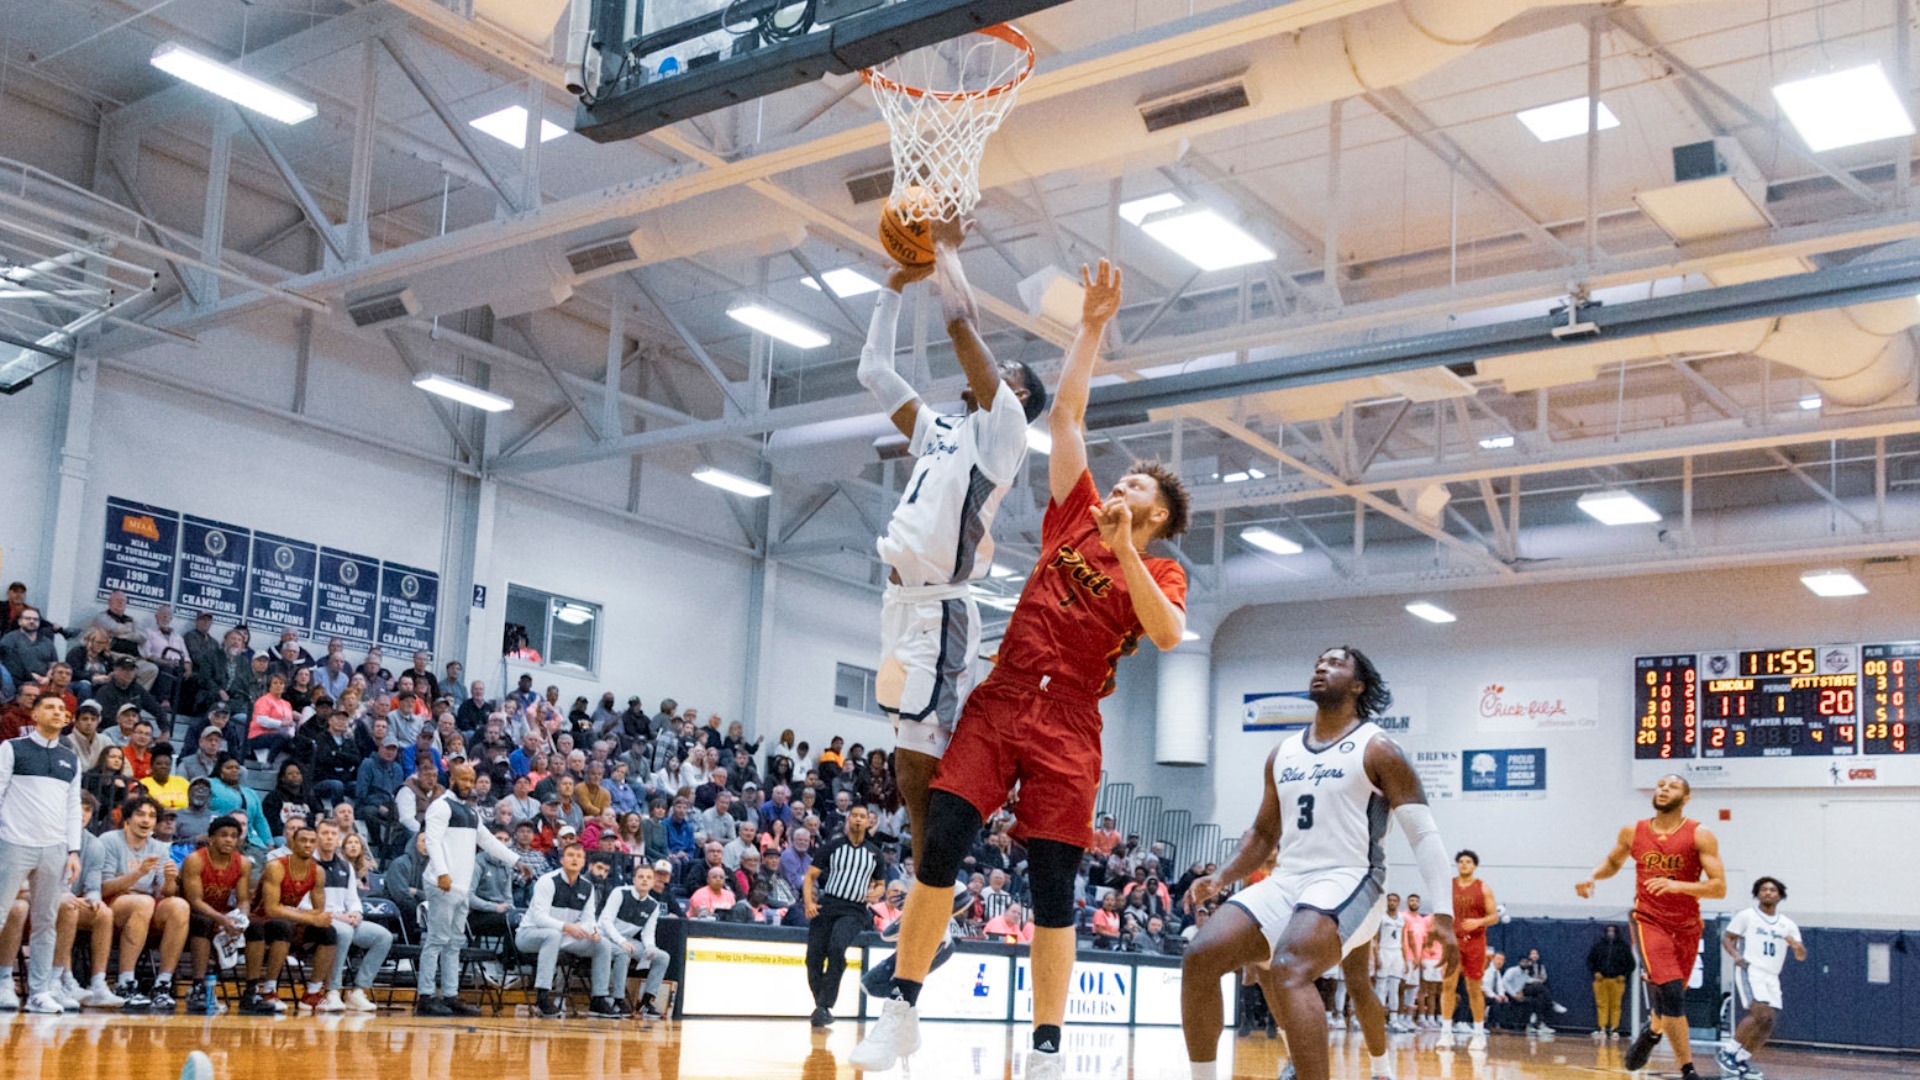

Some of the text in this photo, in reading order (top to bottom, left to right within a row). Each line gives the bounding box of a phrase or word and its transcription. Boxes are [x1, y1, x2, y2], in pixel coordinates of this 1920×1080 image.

[105, 577, 165, 598] CHAMPIONS
[201, 585, 222, 598] 1999
[475, 587, 484, 602] 2
[182, 593, 237, 612] CHAMPIONS
[270, 599, 290, 612] 2001
[253, 608, 305, 626] CHAMPIONS
[320, 621, 369, 639] CHAMPIONS
[382, 632, 429, 650] CHAMPIONS
[1750, 648, 1815, 675] 11:55
[1865, 659, 1904, 676] 00 0
[1646, 669, 1695, 685] 0 1 0
[1877, 675, 1904, 690] 3 1
[1651, 683, 1695, 698] 1 0 2
[1708, 679, 1754, 693] LINCOLN
[1763, 684, 1791, 693] PERIOD
[1647, 698, 1695, 714] 3 0 3
[1722, 695, 1745, 716] 11
[1777, 695, 1785, 713] 1
[1819, 689, 1854, 714] 20
[1876, 691, 1904, 706] 4 0
[1641, 713, 1695, 729] 10 0 0
[1750, 716, 1804, 727] PLAYER FOUL
[1828, 715, 1856, 724] FOULS
[1876, 707, 1904, 722] 5 1
[1637, 728, 1695, 744] 20 1 2
[1711, 727, 1726, 747] 2
[1735, 731, 1745, 746] 3
[1811, 730, 1822, 742] 4
[1838, 725, 1854, 742] 4
[1866, 723, 1904, 739] 23 0
[1661, 743, 1671, 758] 2
[1893, 740, 1905, 752] 4
[1417, 752, 1458, 761] BREWS
[1507, 754, 1535, 764] PROUD
[1278, 764, 1345, 786] Blue Tigers
[1507, 771, 1535, 779] LINCOLN
[1297, 794, 1315, 830] 3
[1642, 852, 1684, 871] Pitt
[1763, 941, 1776, 957] 10
[716, 952, 731, 962] Help
[733, 953, 742, 962] Us
[744, 954, 771, 964] Promote
[778, 956, 802, 965] Positive
[1070, 999, 1117, 1016] TIGERS
